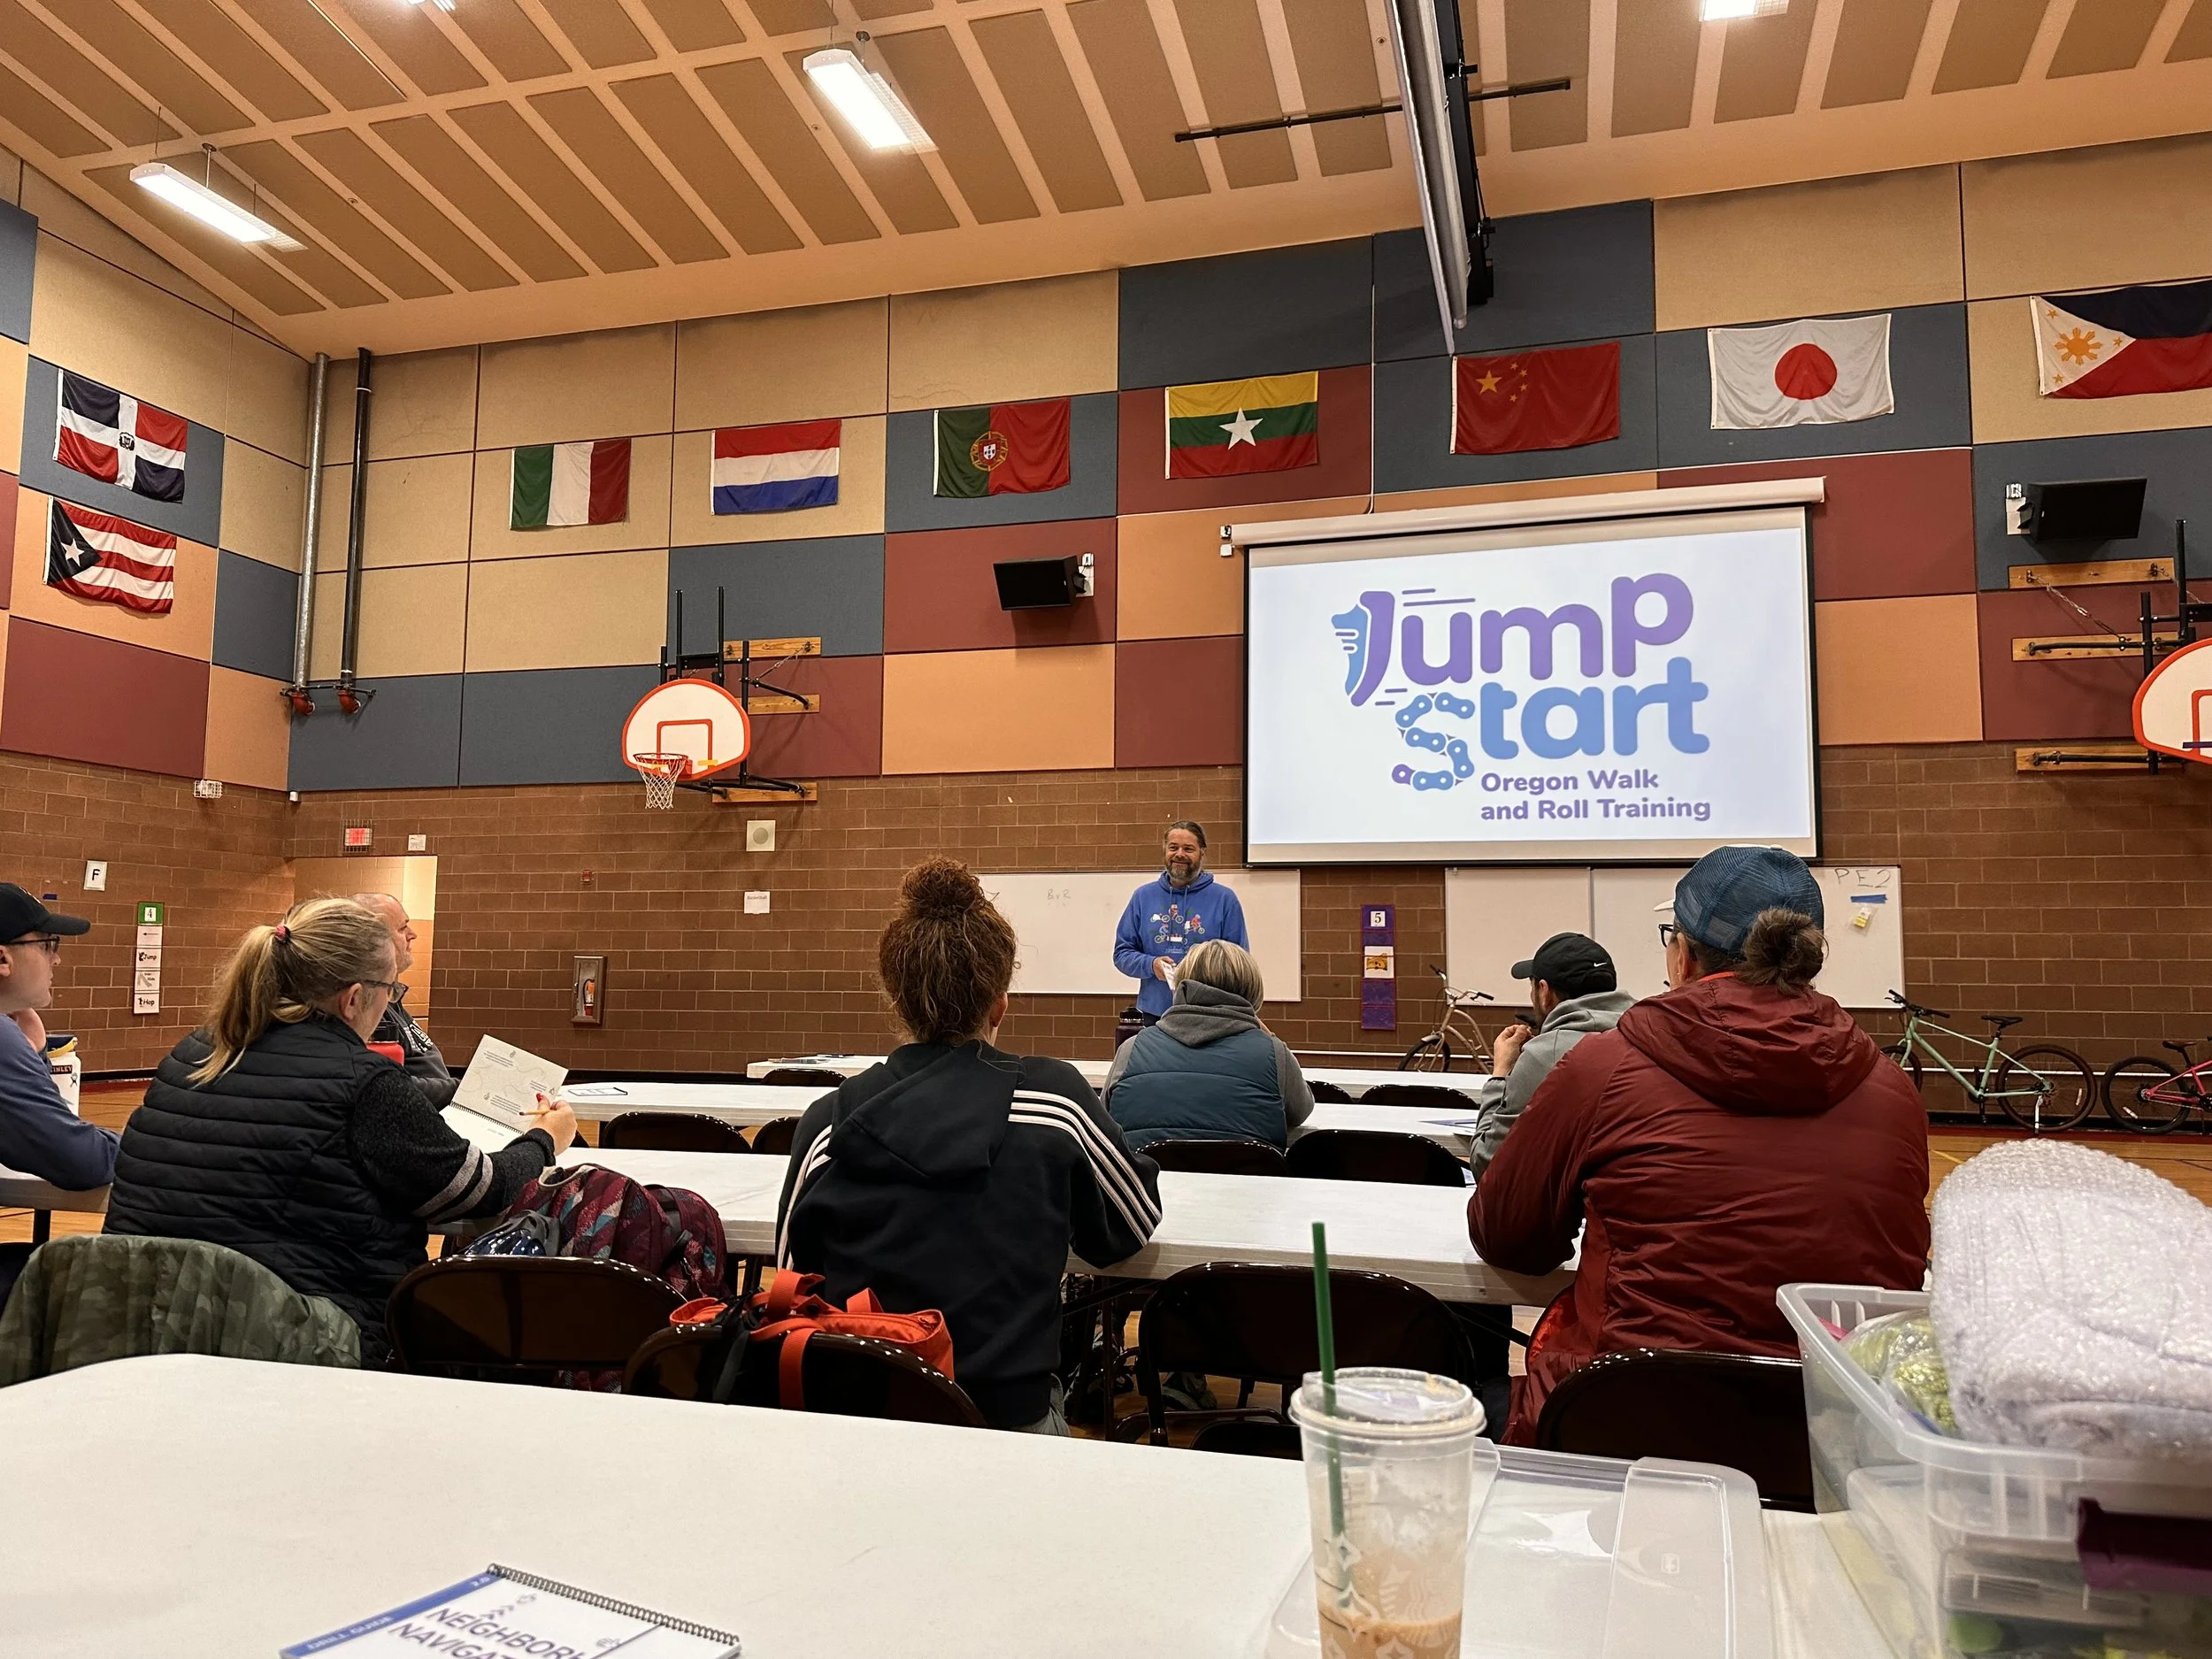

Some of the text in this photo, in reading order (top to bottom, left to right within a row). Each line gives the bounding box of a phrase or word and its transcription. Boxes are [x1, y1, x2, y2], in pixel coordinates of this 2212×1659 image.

[1350, 572, 1694, 707] Jump
[1480, 769, 1659, 795] Oregon Walk
[1480, 796, 1711, 822] and Roll Training
[92, 868, 101, 881] F
[1373, 912, 1382, 924] 5
